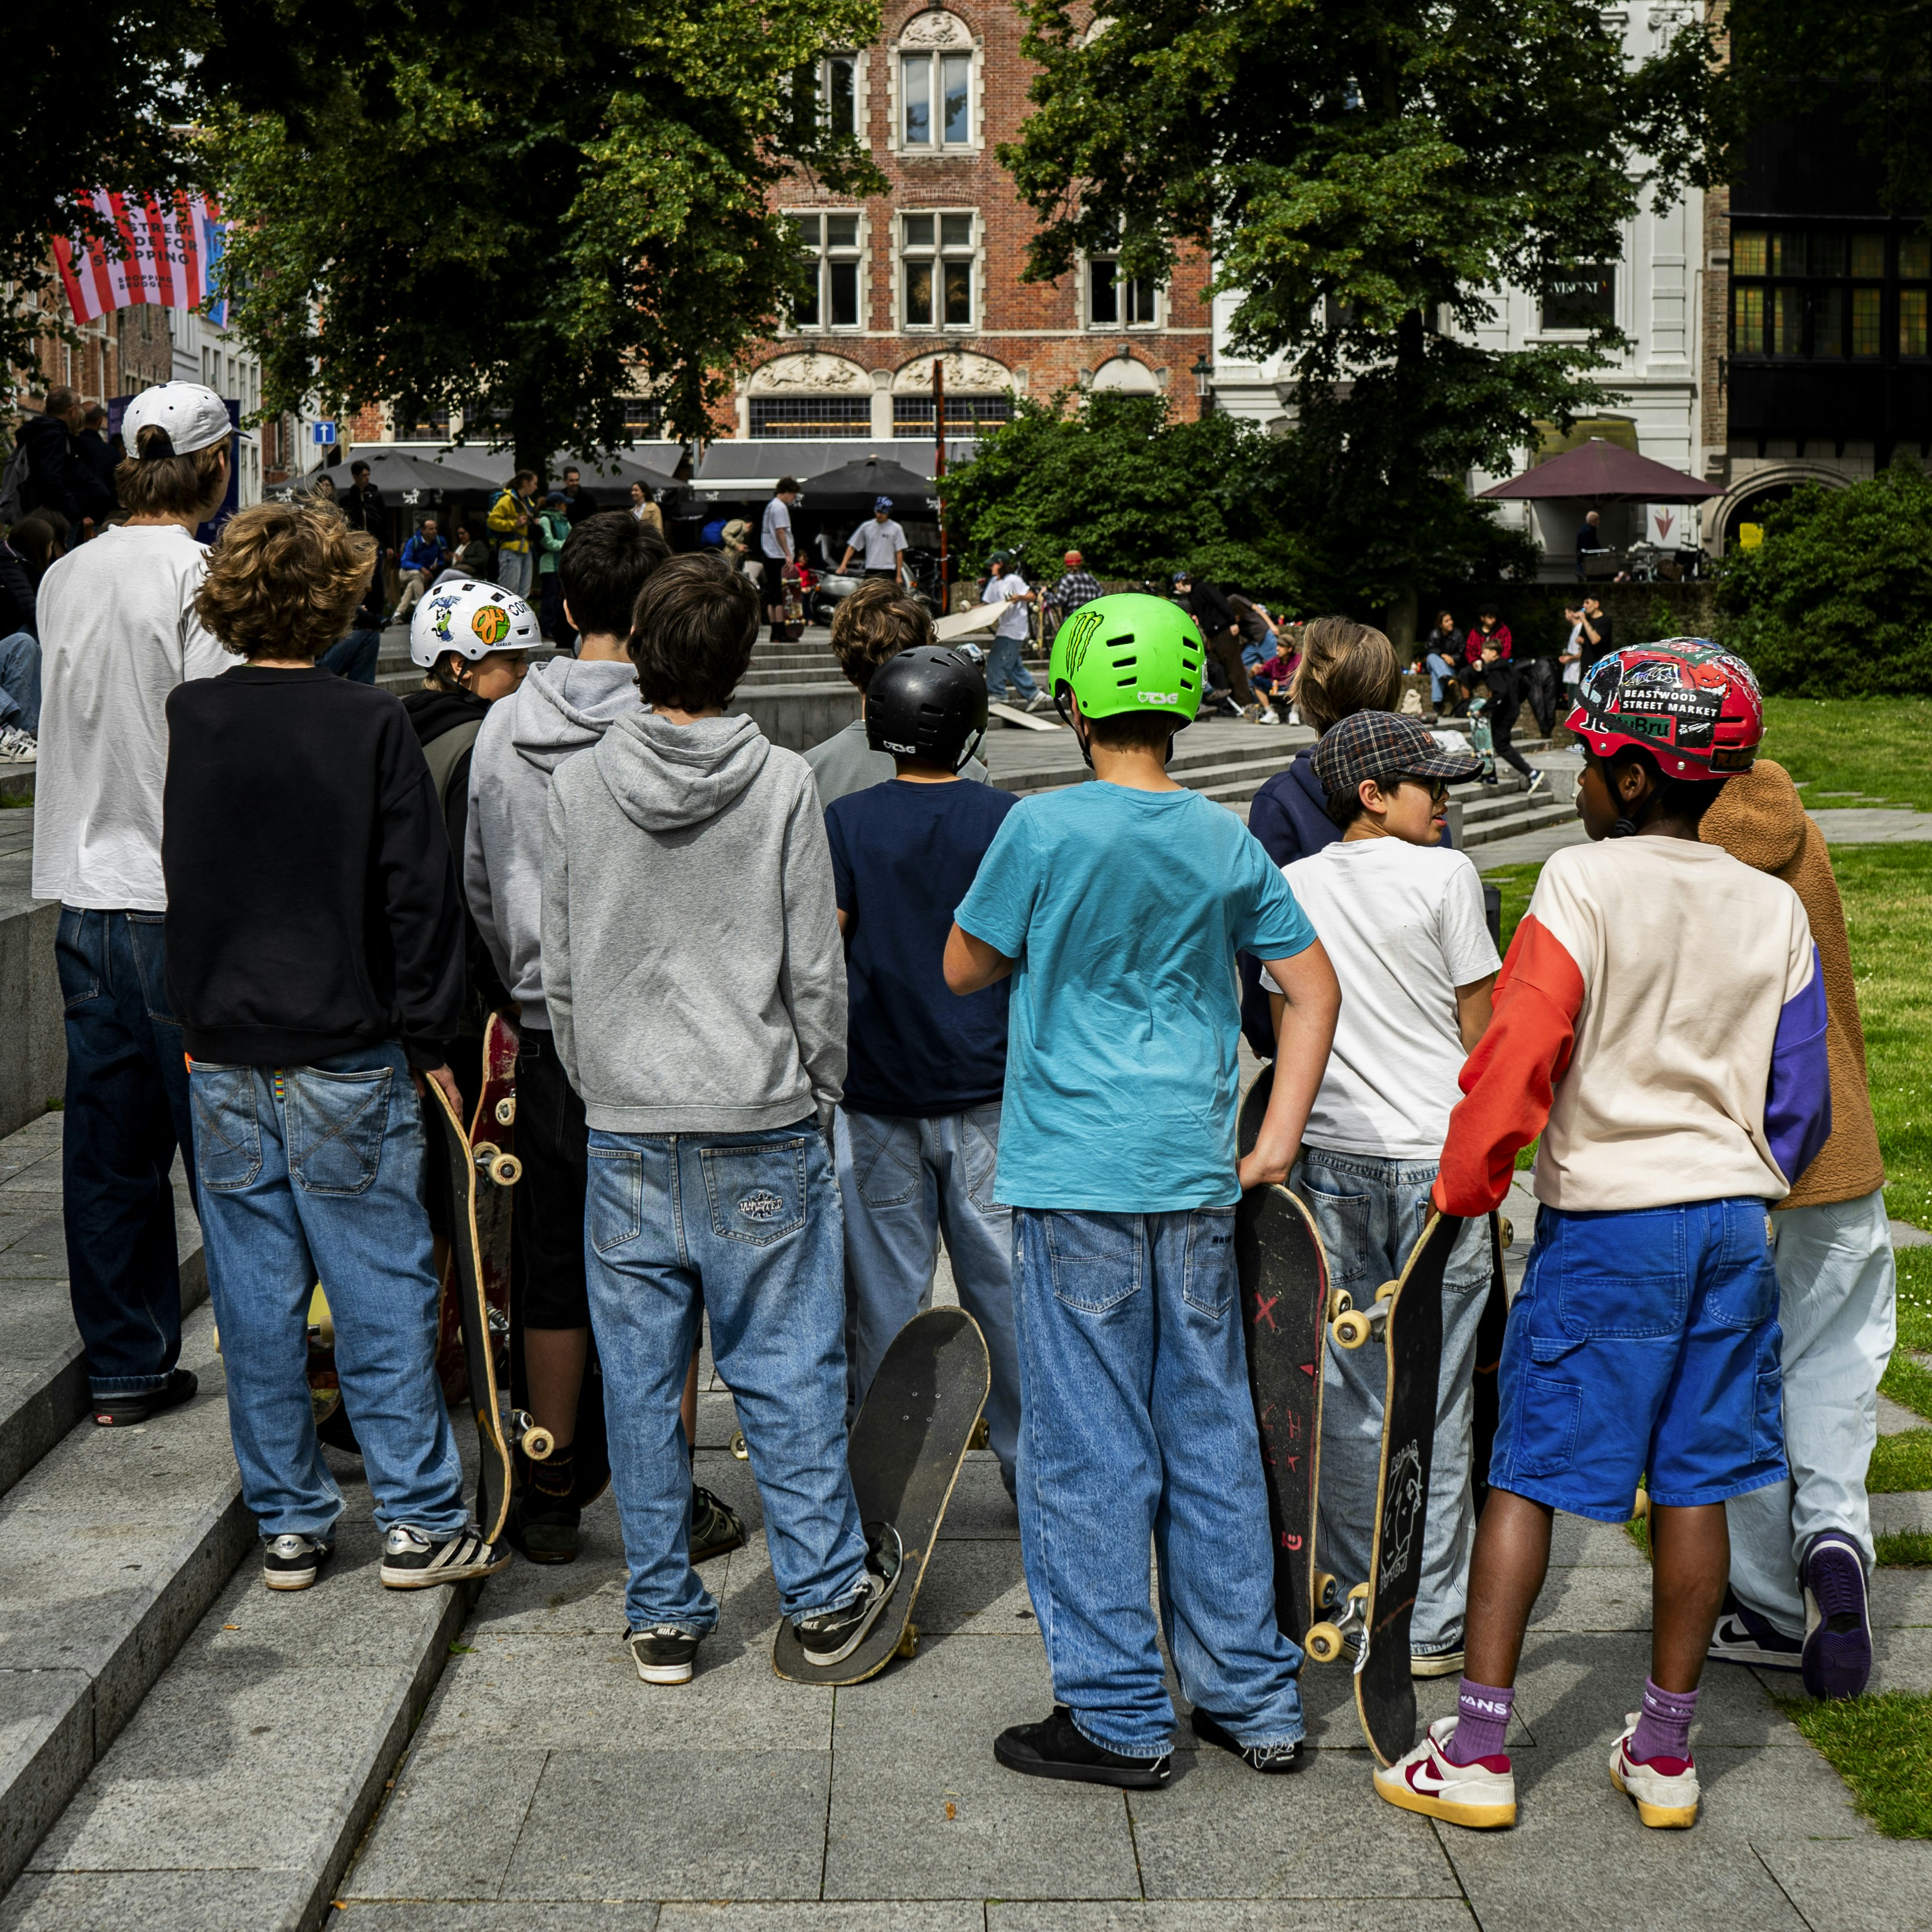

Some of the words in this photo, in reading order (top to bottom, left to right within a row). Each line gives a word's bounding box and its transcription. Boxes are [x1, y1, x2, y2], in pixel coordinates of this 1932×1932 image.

[128, 223, 194, 235] STREET
[113, 235, 157, 247] ADE
[164, 237, 197, 252] FOR
[93, 250, 190, 267] SHOPPING
[118, 274, 172, 283] SHOPPING
[119, 281, 162, 290] BRUGGE
[1624, 690, 1697, 702] BEASTWOOD
[1623, 700, 1664, 710] STREET
[1668, 703, 1718, 717] MARKET
[657, 1627, 676, 1636] NIKE
